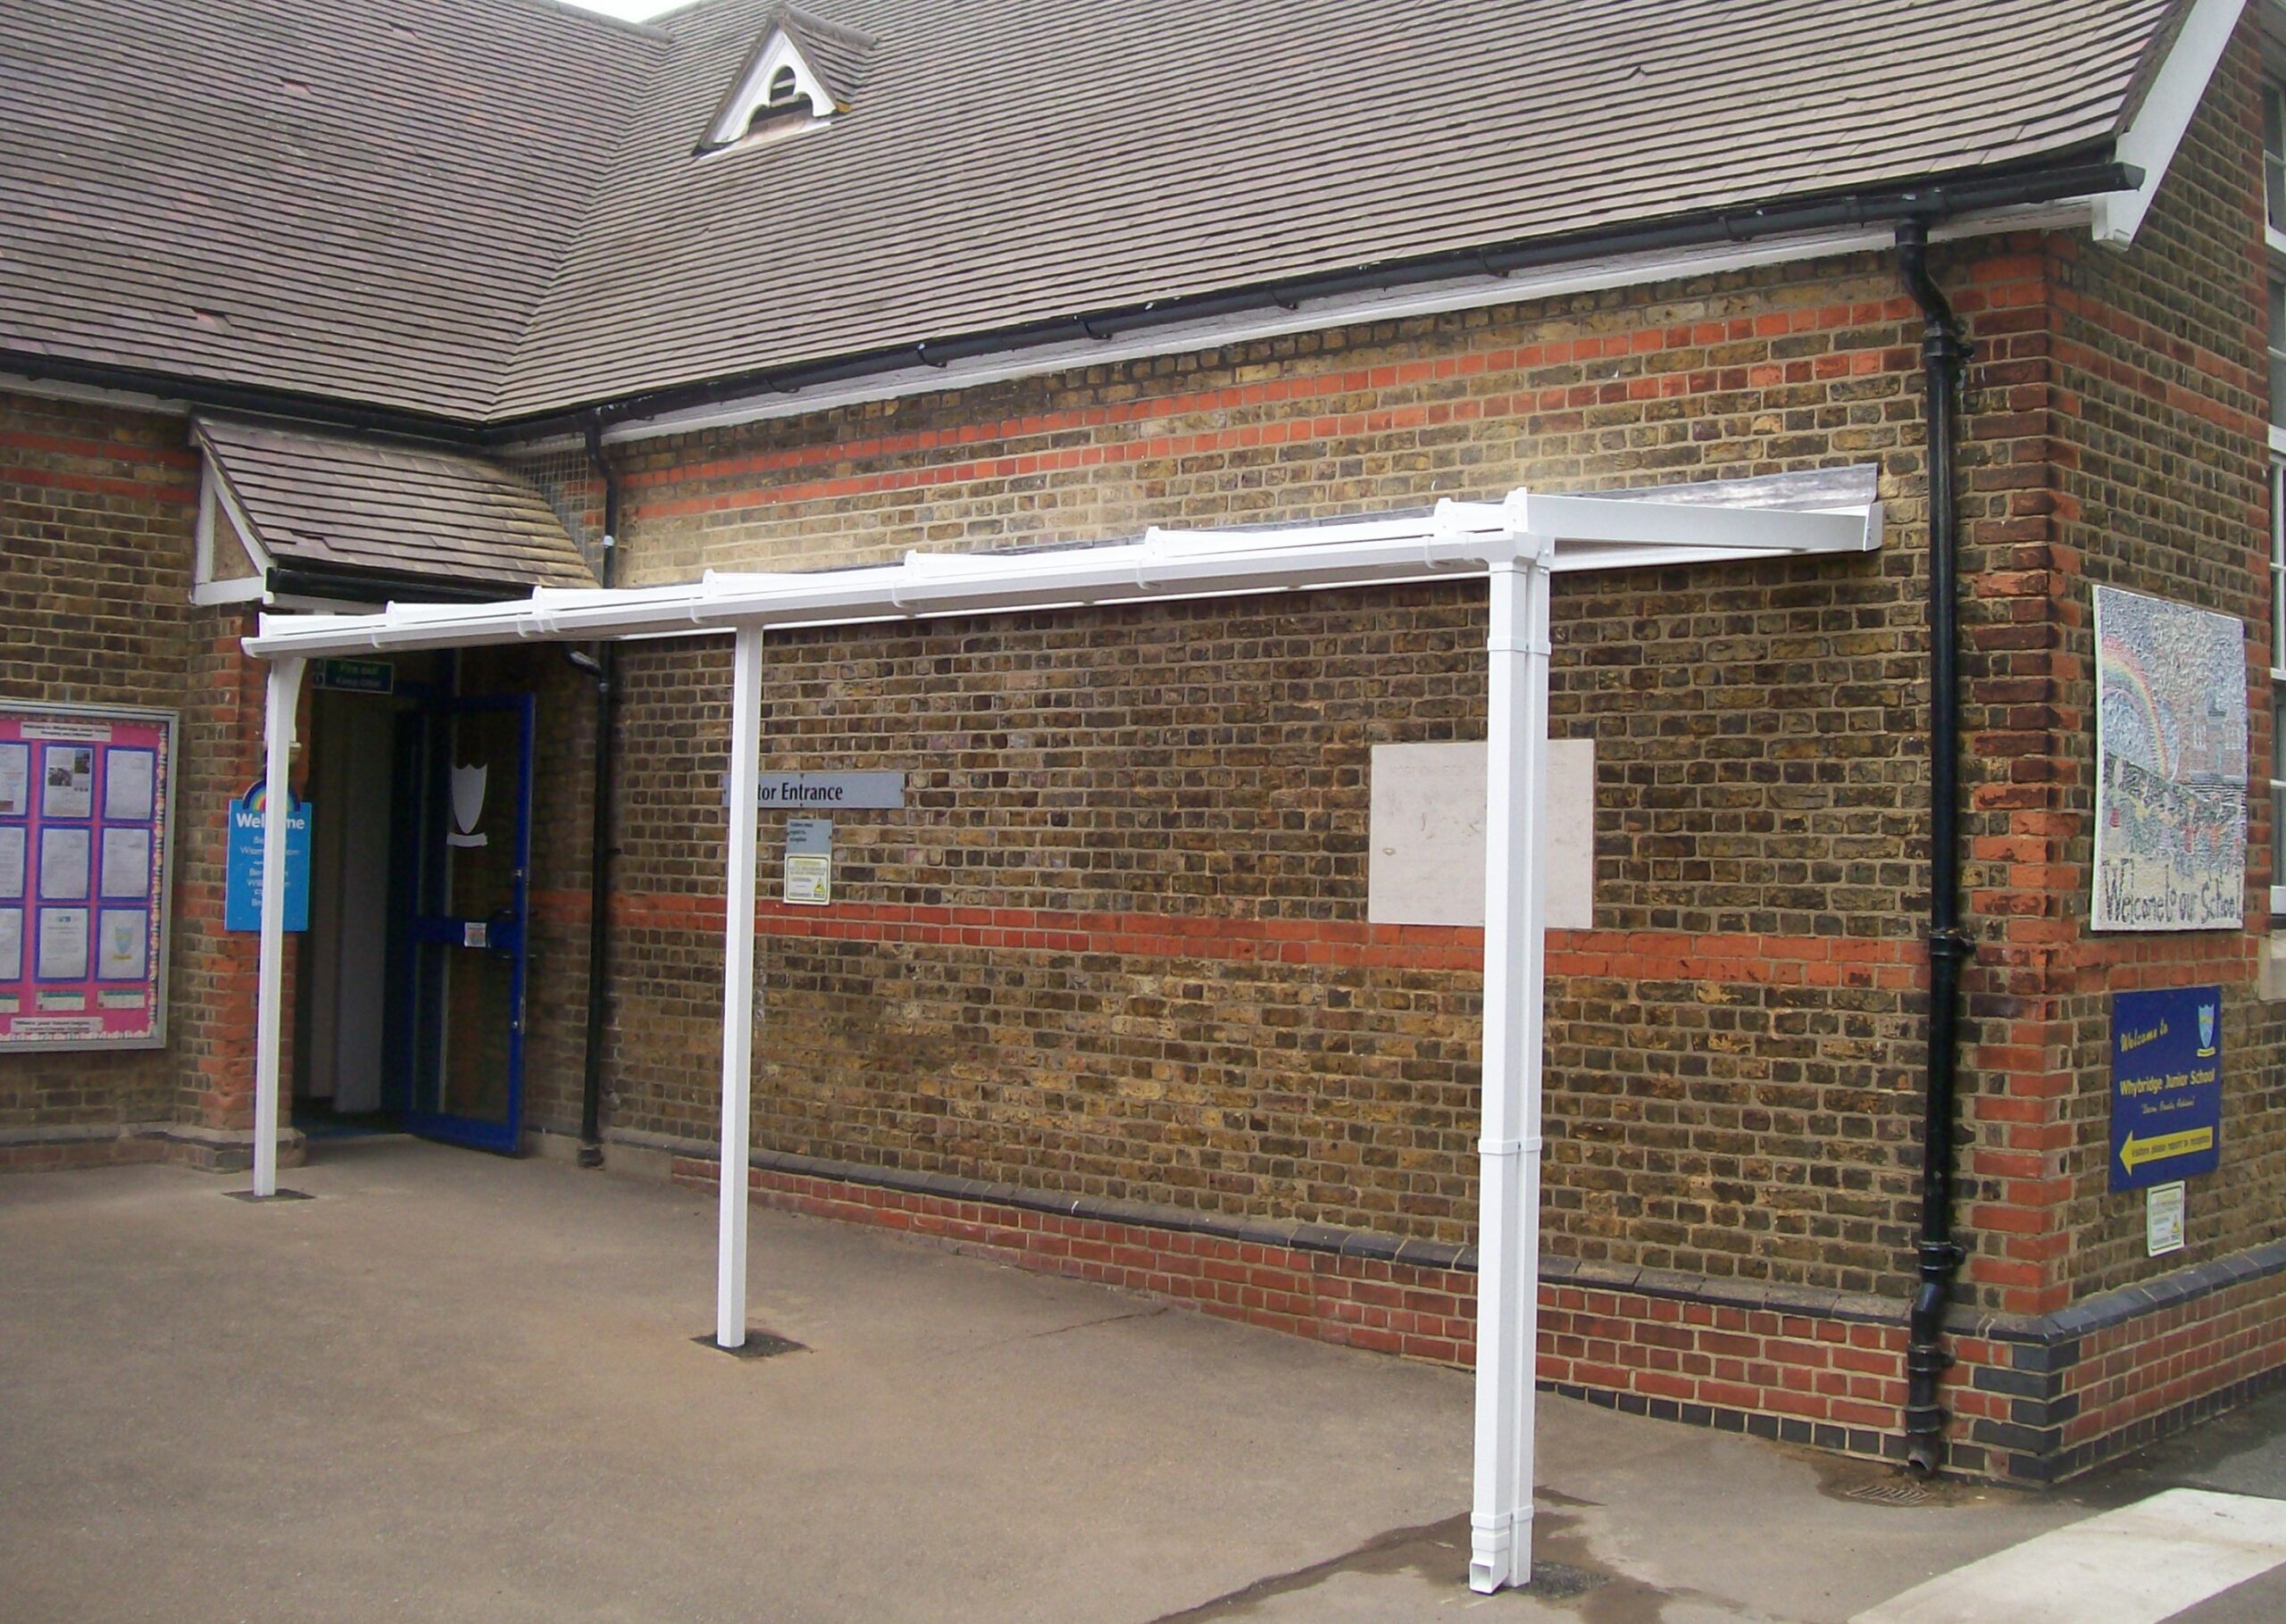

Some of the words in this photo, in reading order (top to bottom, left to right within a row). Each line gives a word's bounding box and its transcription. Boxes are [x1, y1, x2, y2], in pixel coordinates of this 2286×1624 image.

[781, 782, 843, 801] Entrance
[235, 812, 305, 829] Welme
[2102, 858, 2165, 925] Welcome
[2180, 892, 2198, 923] our
[2120, 1028, 2158, 1053] Welcome
[2159, 1017, 2169, 1036] to
[2120, 1076, 2163, 1098] Whybridge
[2165, 1071, 2190, 1089] Junior
[2190, 1068, 2215, 1086] School
